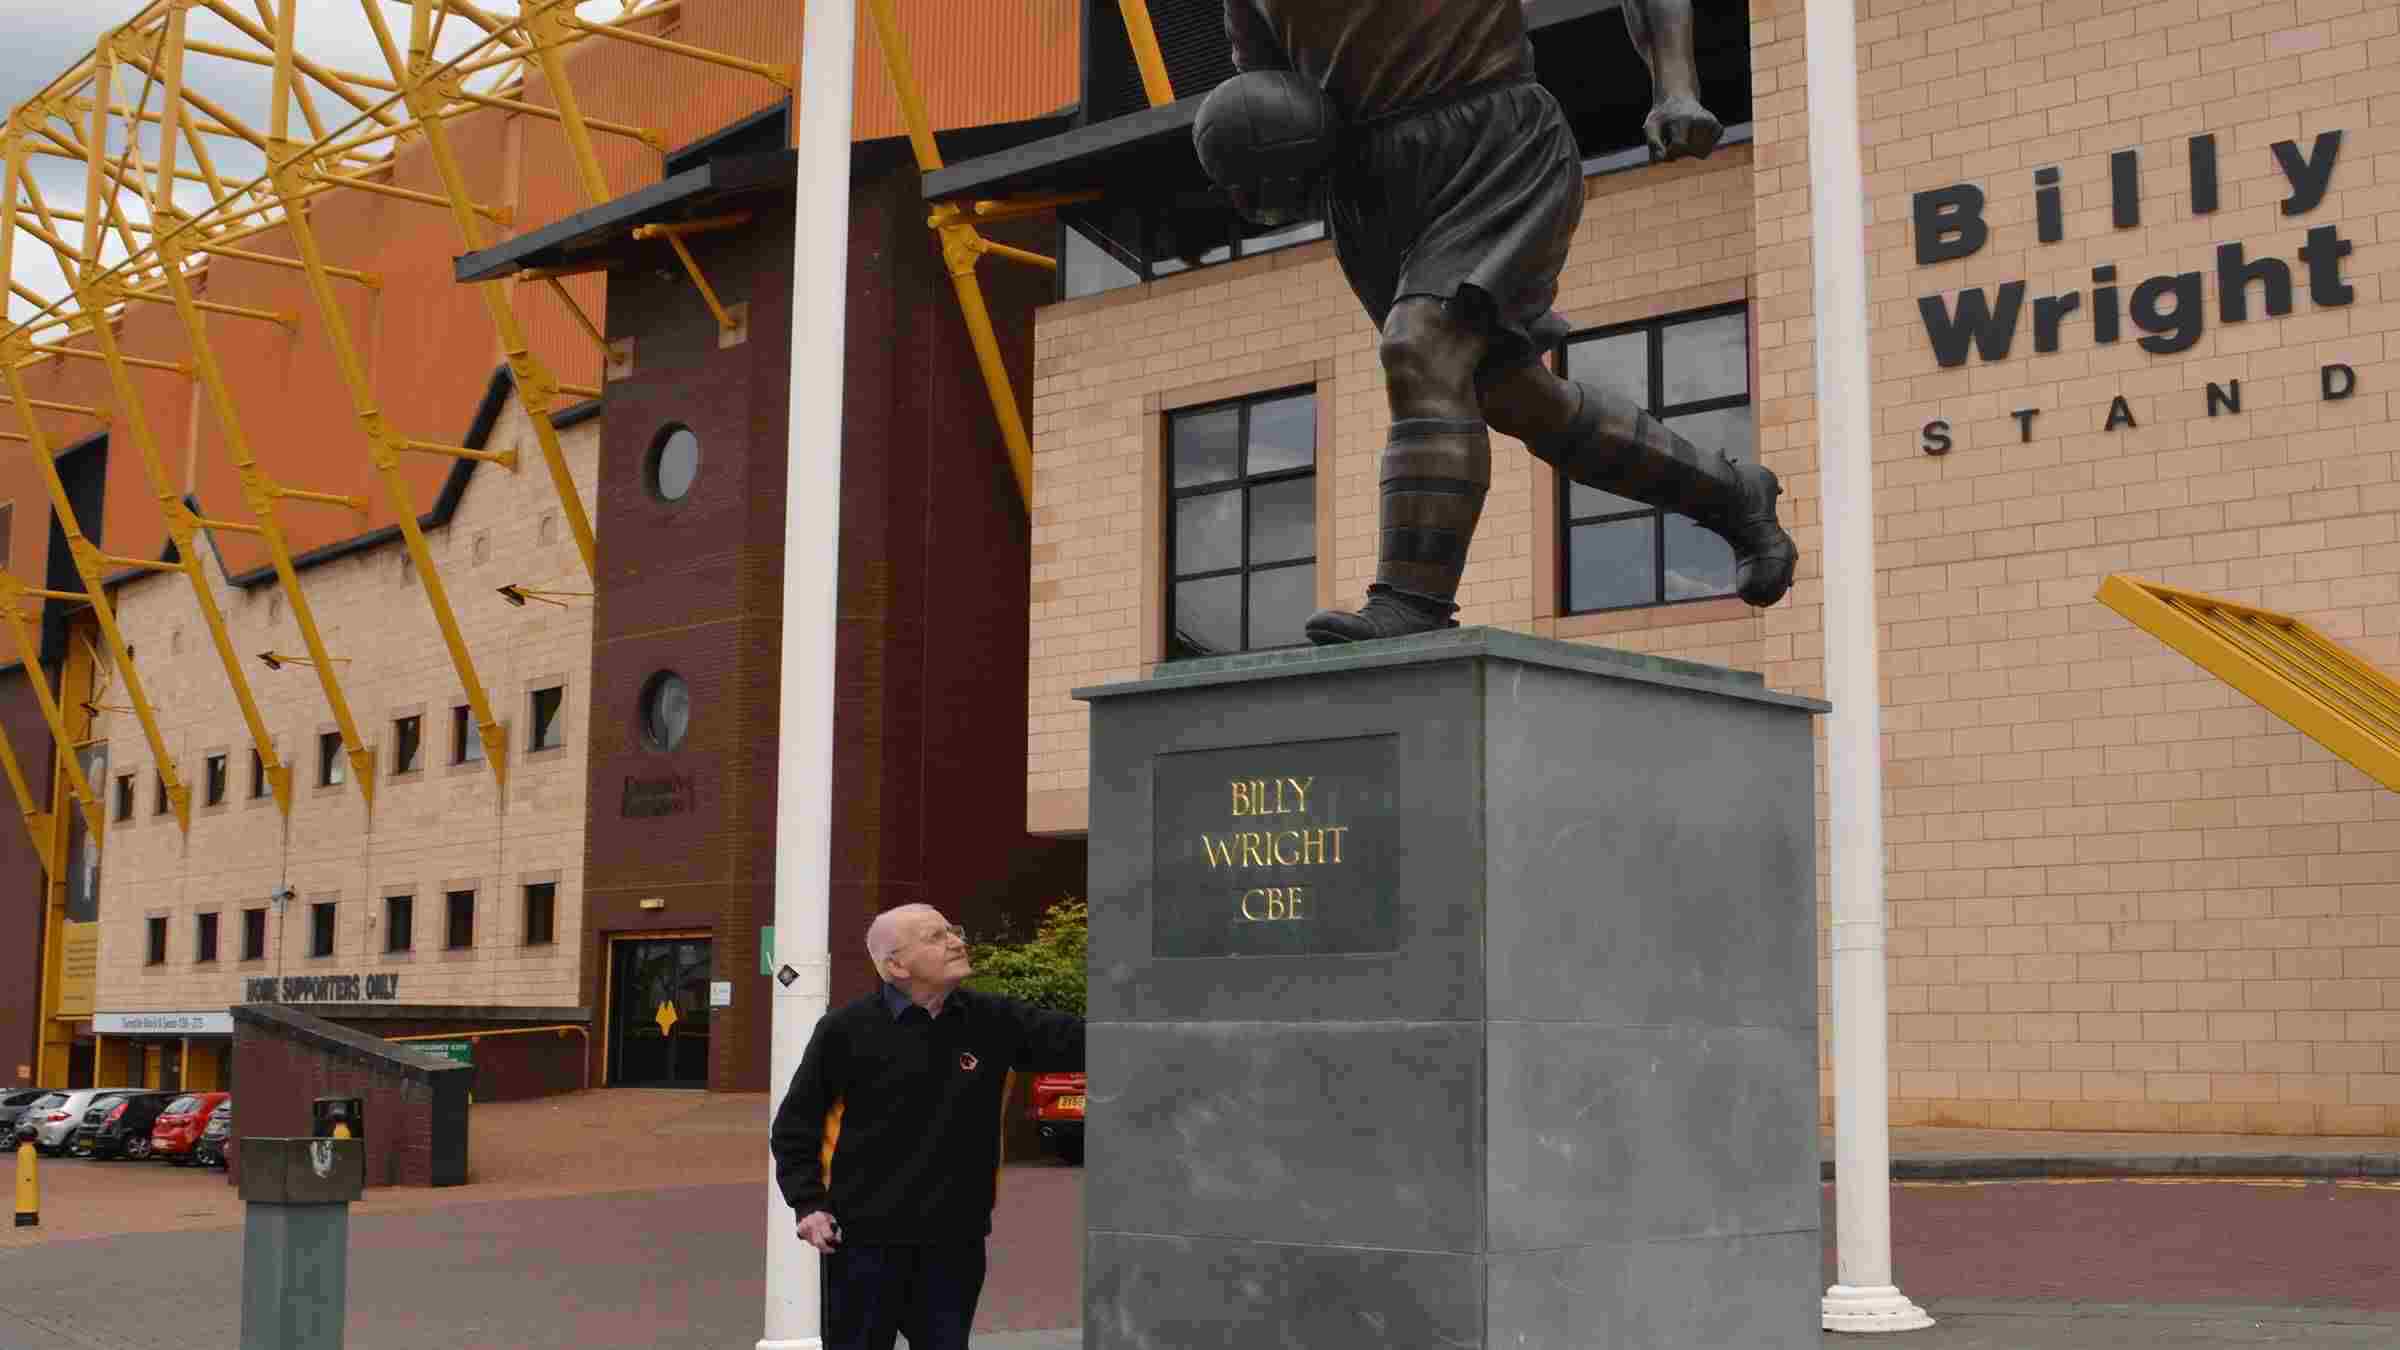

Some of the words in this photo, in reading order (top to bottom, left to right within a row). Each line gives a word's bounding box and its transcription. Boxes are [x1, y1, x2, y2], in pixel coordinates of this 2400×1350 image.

[1912, 129, 2343, 265] Billy
[1917, 224, 2354, 368] Wright
[1921, 363, 2356, 457] STAND
[1231, 776, 1315, 816] BILLY
[1201, 826, 1349, 869] WRIGHT
[1241, 886, 1305, 921] CBE
[282, 974, 361, 1003] SUPPORTERS
